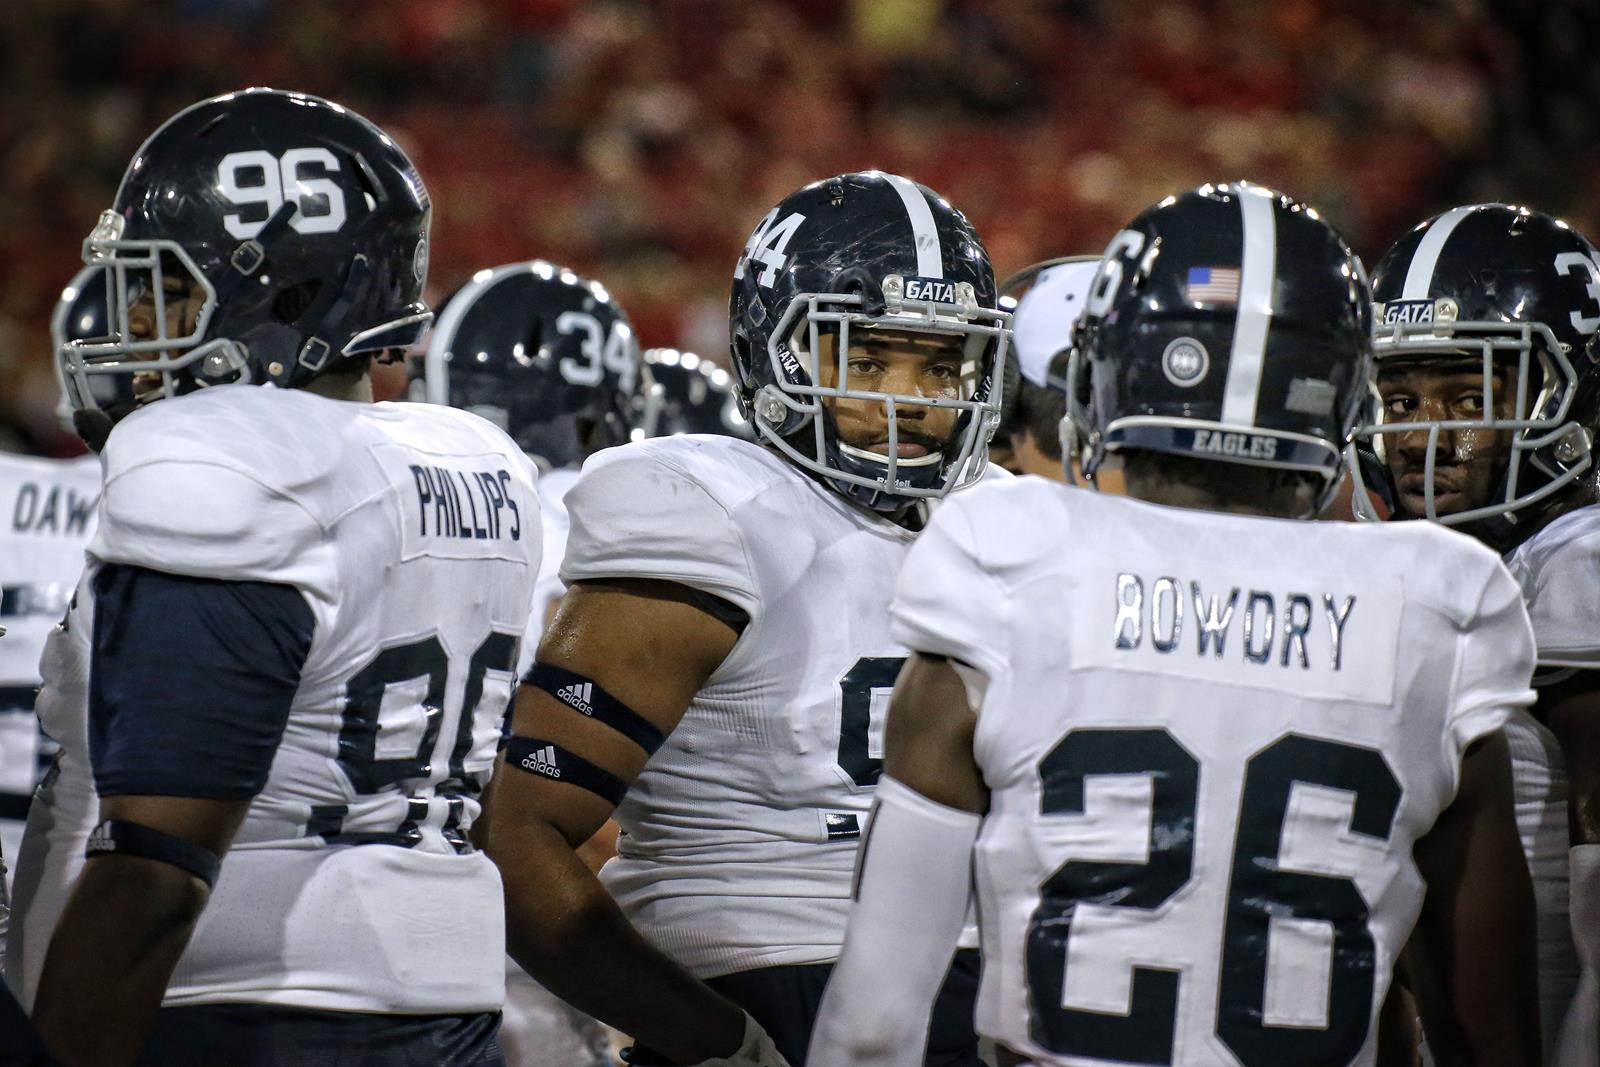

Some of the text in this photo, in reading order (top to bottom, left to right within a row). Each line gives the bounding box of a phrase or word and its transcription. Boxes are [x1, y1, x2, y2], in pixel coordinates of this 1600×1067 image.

[217, 147, 347, 240] 96
[905, 280, 954, 303] GATA
[1385, 303, 1434, 325] GATA
[1553, 250, 1600, 335] 3
[556, 310, 637, 396] 34
[1192, 429, 1278, 461] EAGLES
[408, 463, 520, 542] PHILLIPS
[1114, 572, 1357, 672] BOWDRY
[557, 688, 593, 716] adidas
[521, 758, 561, 778] adidas
[1024, 725, 1405, 1067] 26
